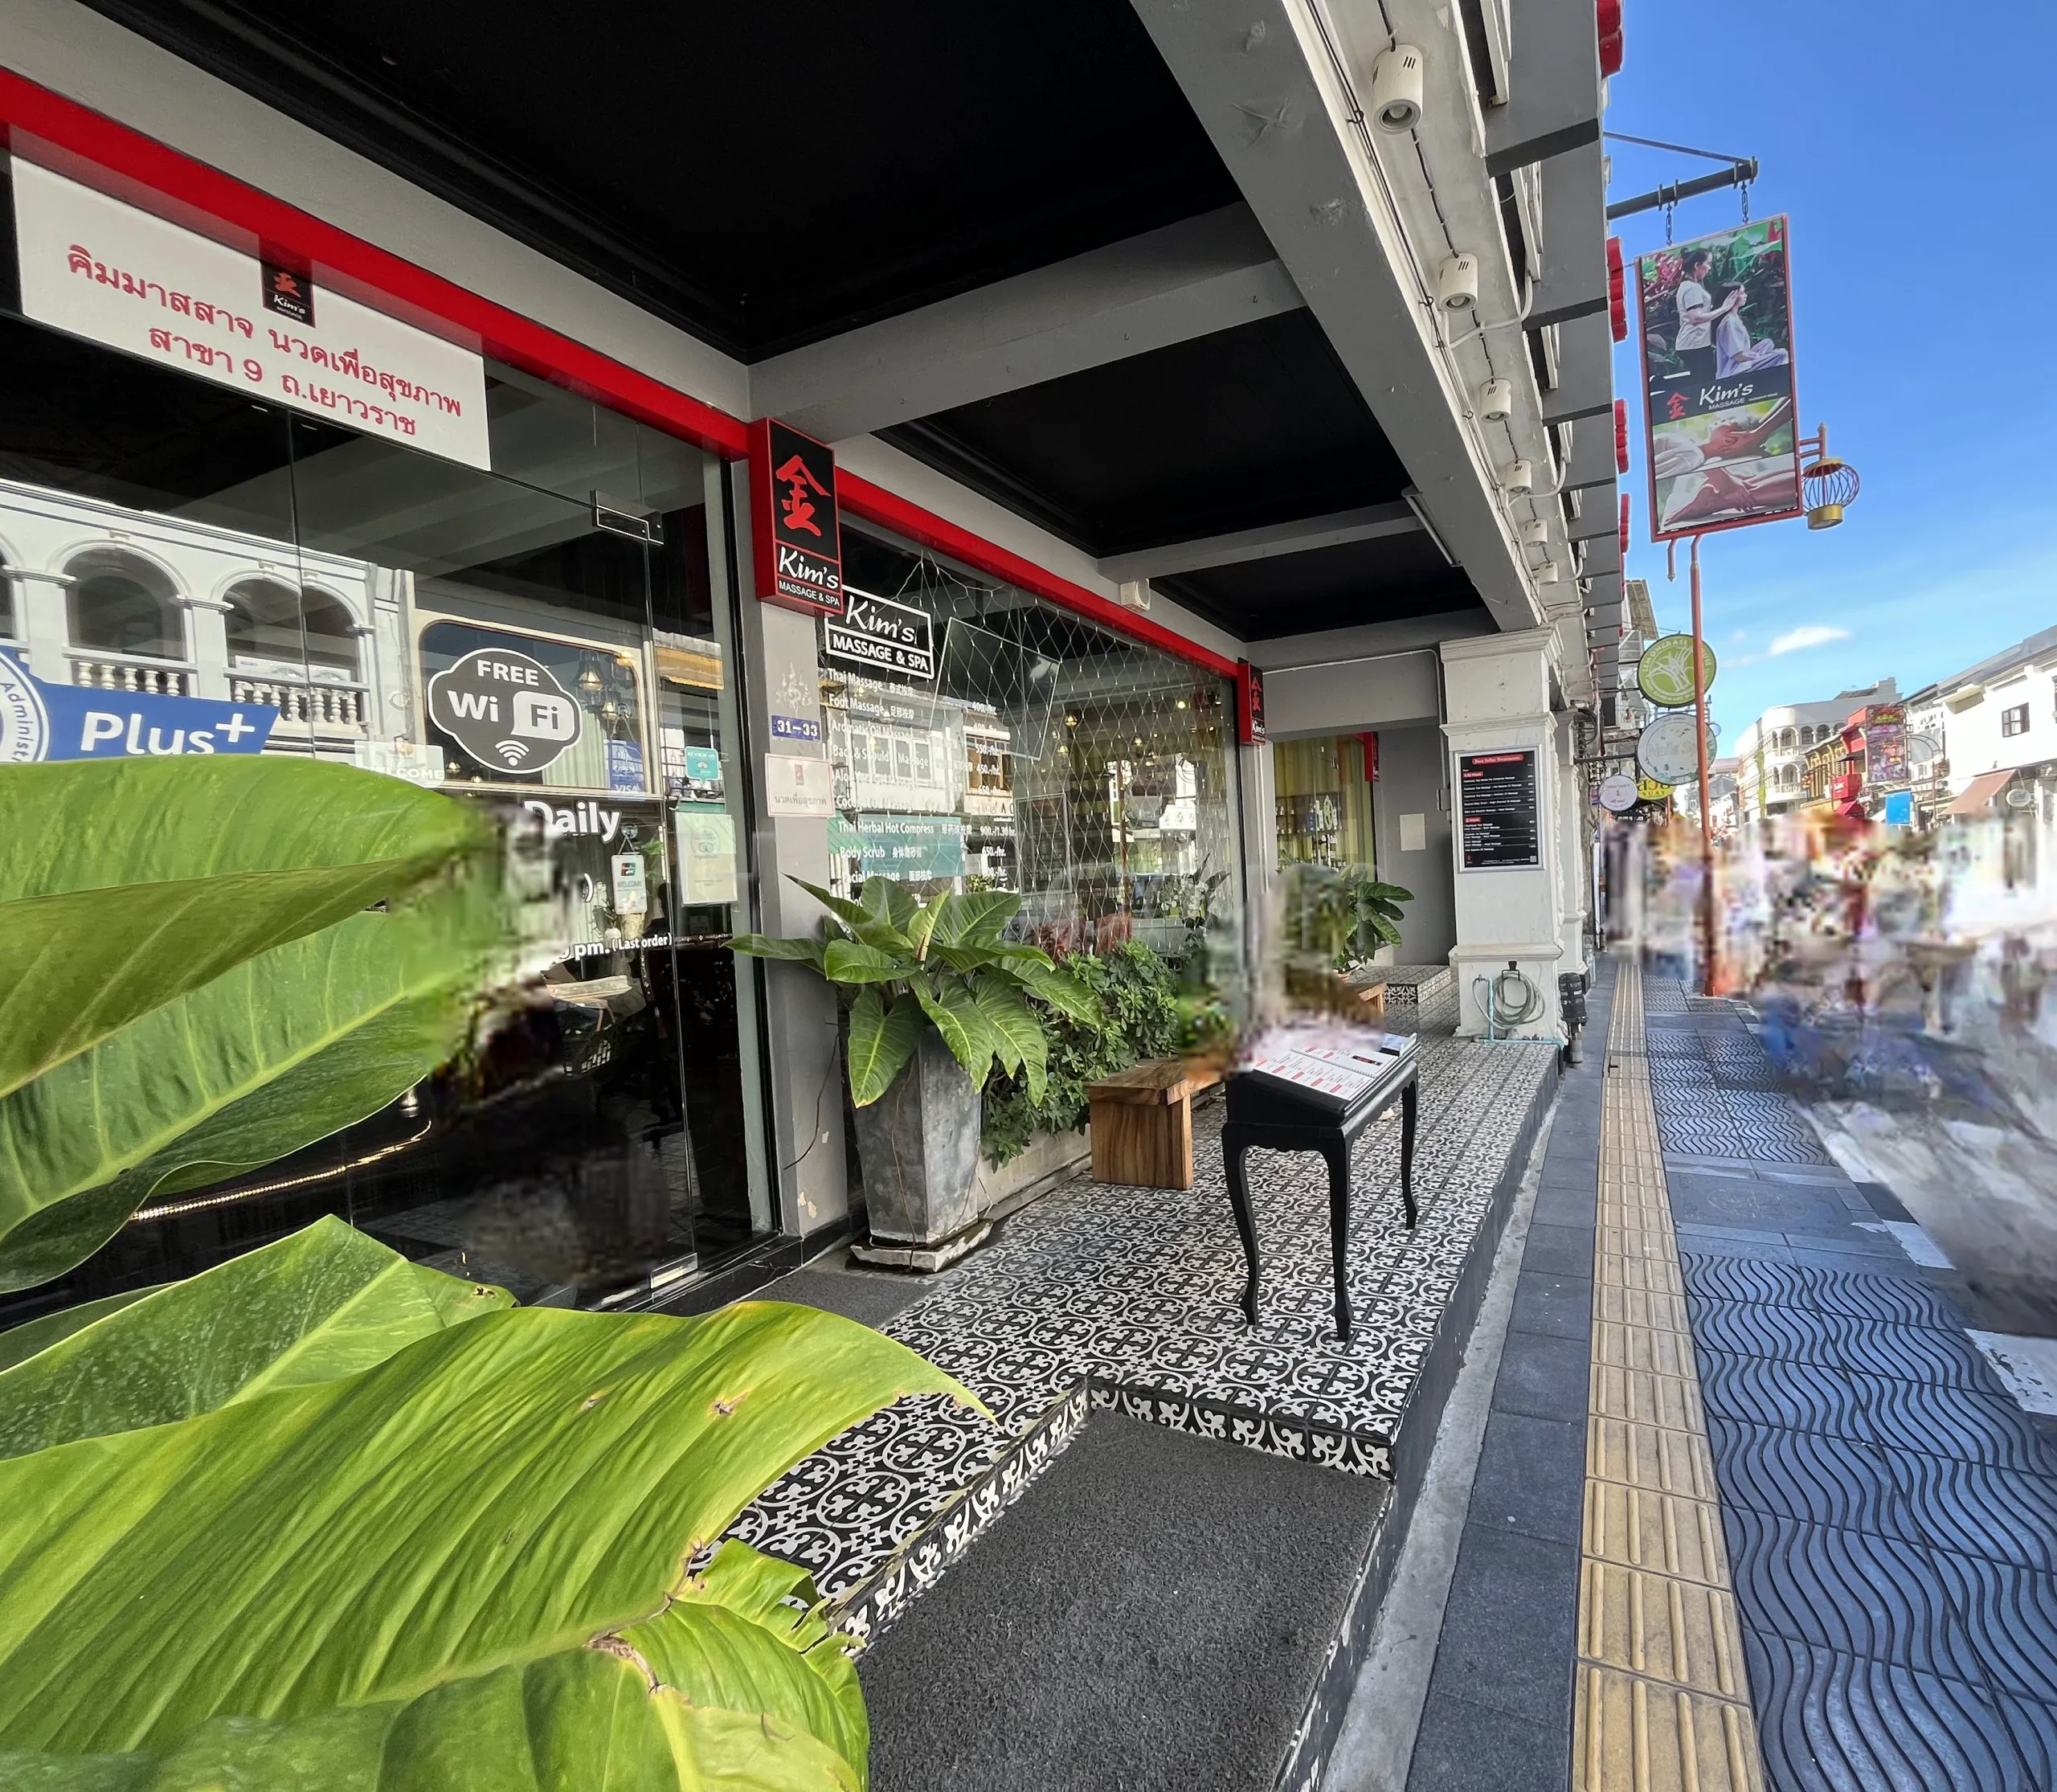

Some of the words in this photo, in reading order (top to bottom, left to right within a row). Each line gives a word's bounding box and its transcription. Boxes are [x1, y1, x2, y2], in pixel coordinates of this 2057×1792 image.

[273, 294, 306, 314] Kim's
[149, 327, 233, 374] สาขา
[243, 358, 263, 383] 9
[280, 374, 415, 436] ถ.เยาวราช
[1699, 383, 1753, 405] Kim's
[1708, 397, 1745, 411] MASSAGE
[779, 546, 839, 589] Kim's
[779, 580, 817, 600] MASSAGE
[818, 592, 824, 602] &
[825, 595, 840, 607] SPA
[845, 595, 915, 642] Kim's
[832, 633, 892, 661] MASSAGE
[896, 650, 906, 665] &
[907, 653, 929, 671] SPA
[476, 659, 540, 687] FREE
[827, 668, 847, 684] Thai
[848, 672, 883, 693] Massage
[447, 689, 498, 722] Wi
[530, 704, 559, 730] Fi
[828, 693, 849, 710] Foot
[850, 699, 884, 716] Massage
[80, 710, 256, 755] Plus+
[777, 720, 818, 737] 31-33
[1252, 719, 1265, 734] Kim's
[524, 801, 622, 842] Daily
[838, 821, 857, 833] Thai
[857, 822, 884, 834] Herbal
[885, 822, 900, 834] Hot
[900, 822, 934, 837] Compress
[839, 846, 861, 861] Body
[862, 846, 885, 858] Scrub
[617, 880, 643, 888] WELCOME
[982, 867, 1007, 878] 00.-/hr.
[573, 942, 611, 962] pm.
[644, 932, 673, 948] order)
